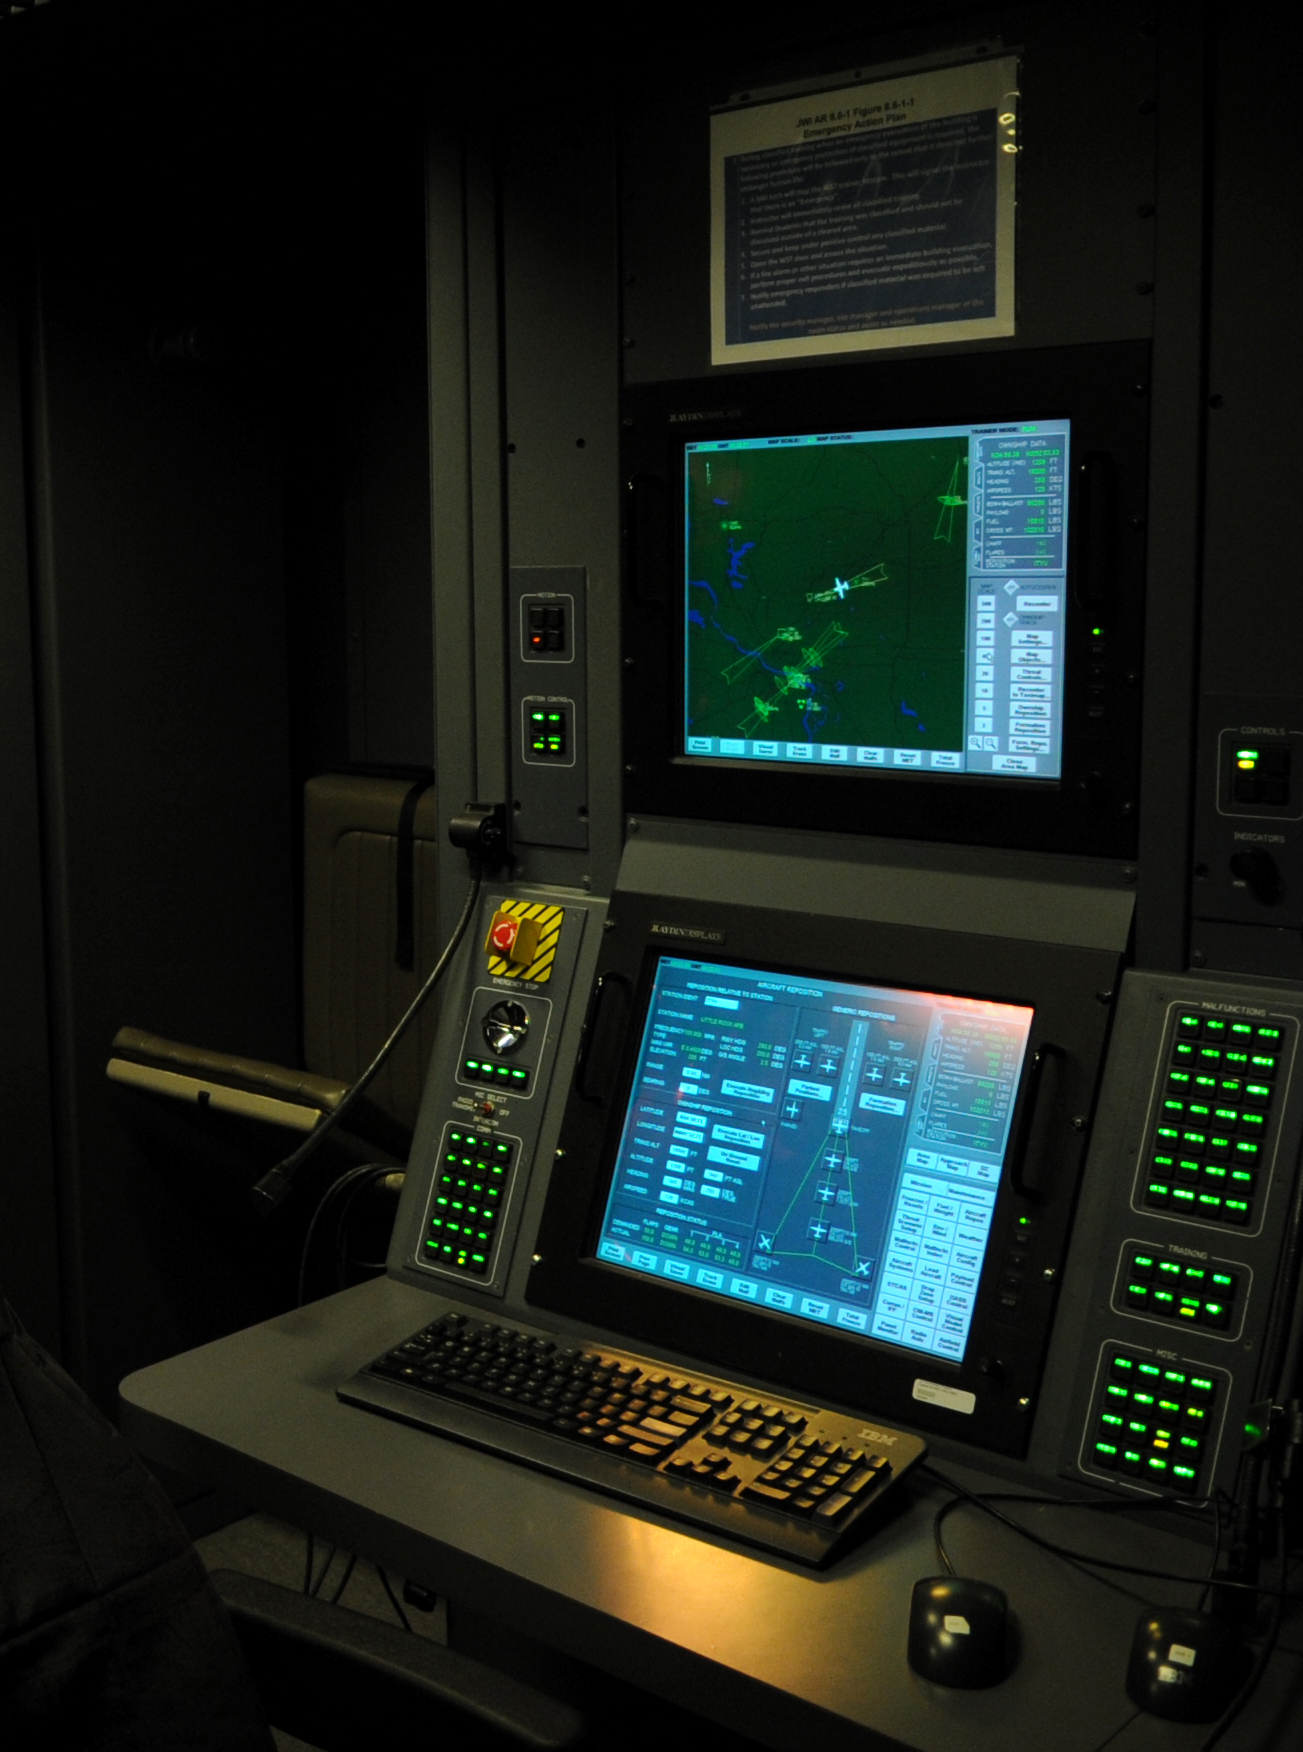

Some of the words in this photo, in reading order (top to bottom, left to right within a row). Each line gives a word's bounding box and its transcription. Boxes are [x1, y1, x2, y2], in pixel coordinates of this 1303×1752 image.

[815, 114, 827, 124] AR
[853, 105, 881, 117] Figure
[803, 124, 852, 138] Emergency
[855, 117, 883, 128] Action
[887, 114, 906, 122] Plan
[1240, 726, 1285, 736] CONTROLS
[1234, 832, 1286, 843] INDICATORS
[492, 978, 523, 988] EMERGENCY
[525, 982, 539, 990] STOP
[1202, 1002, 1267, 1017] MALFUNCTIONS
[1168, 1244, 1208, 1261] TRAINING
[1156, 1349, 1178, 1361] MISC
[857, 1429, 898, 1446] IBM
